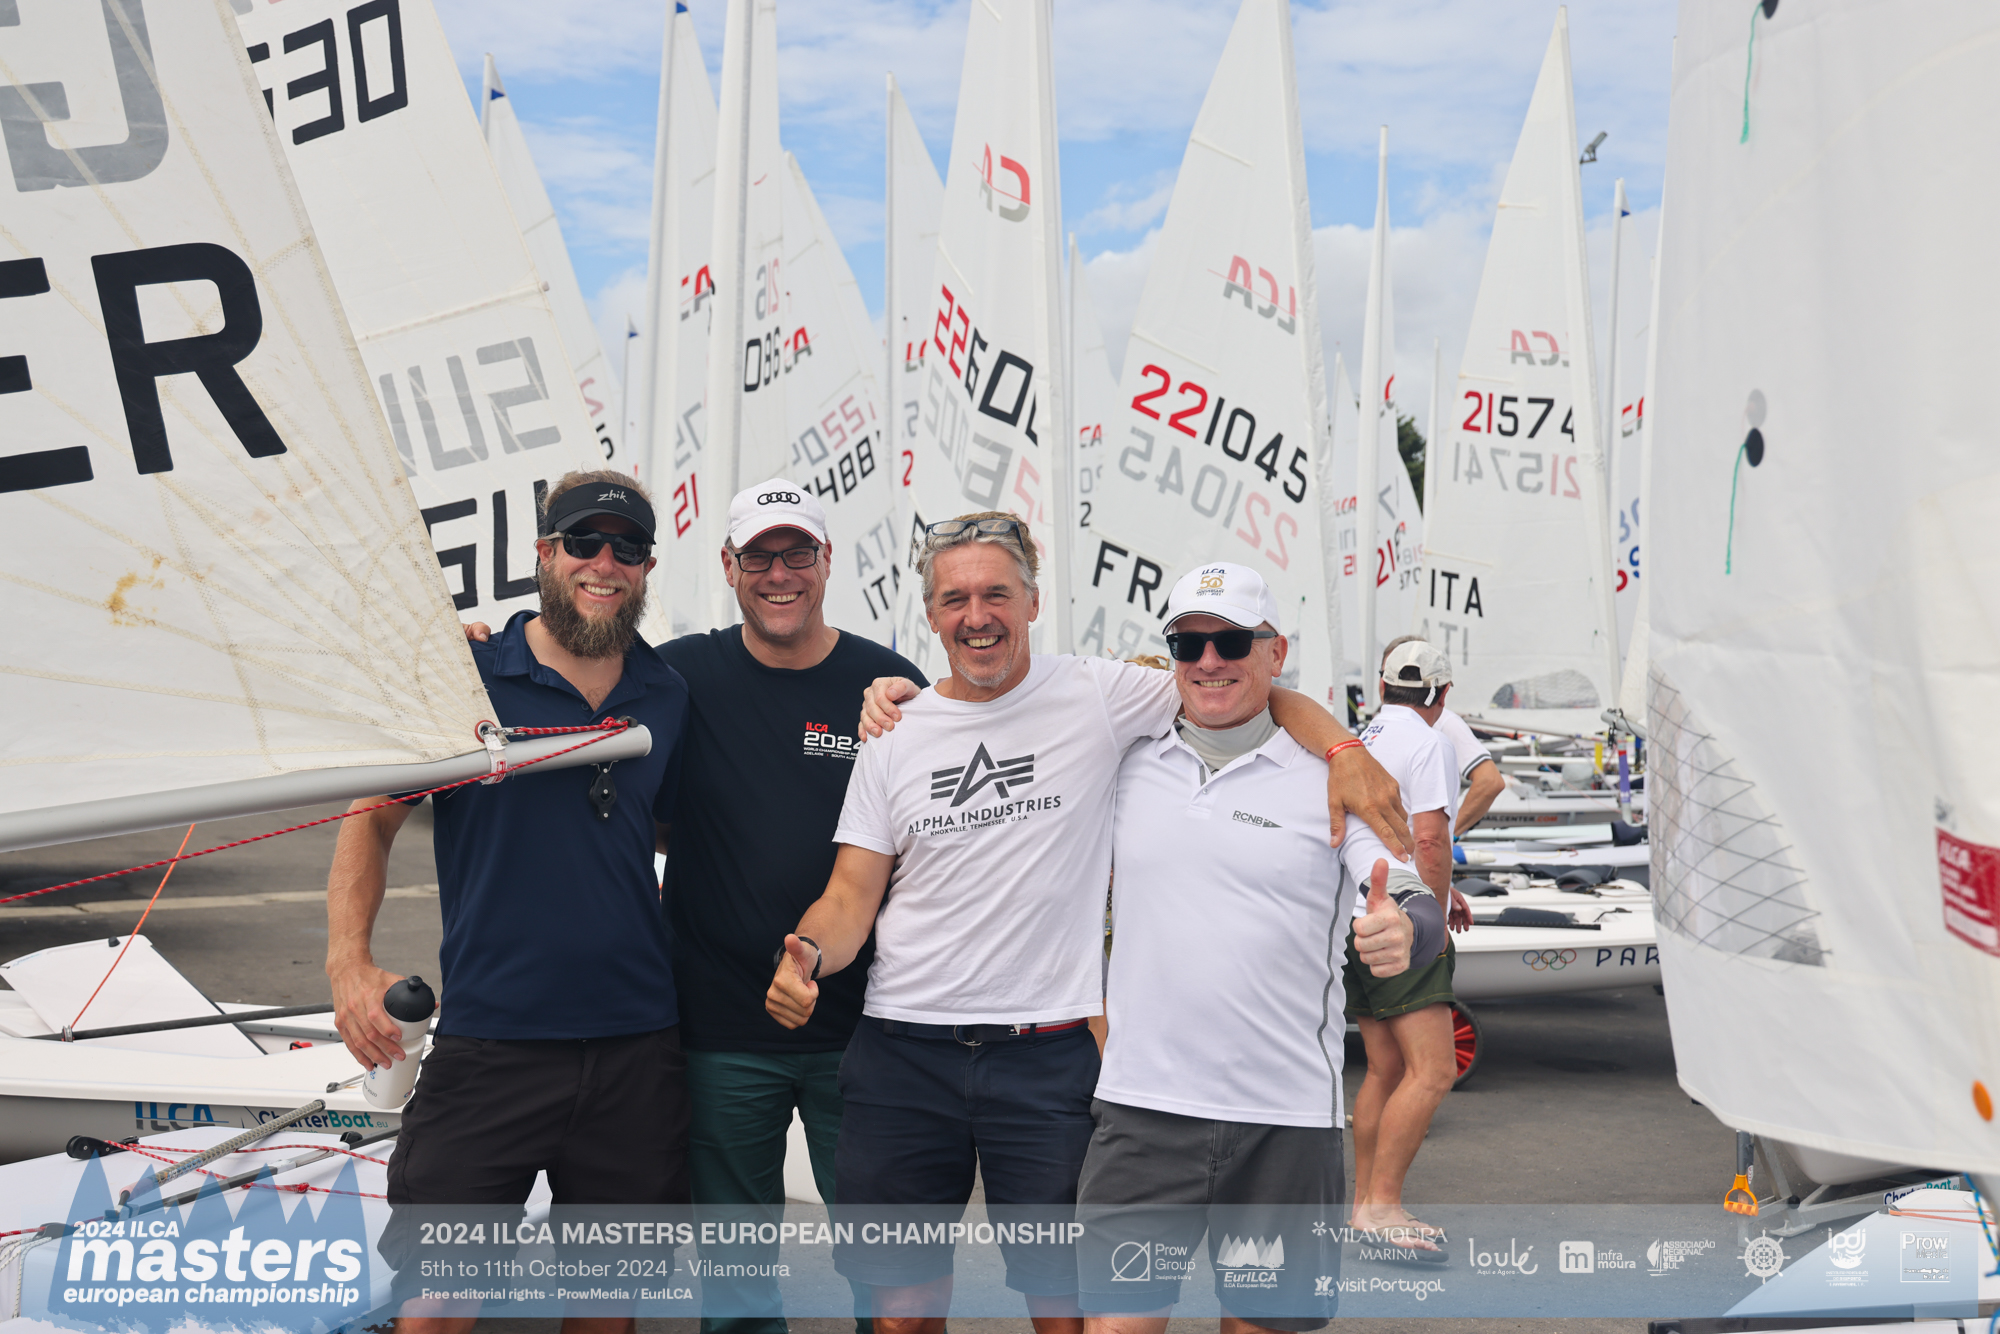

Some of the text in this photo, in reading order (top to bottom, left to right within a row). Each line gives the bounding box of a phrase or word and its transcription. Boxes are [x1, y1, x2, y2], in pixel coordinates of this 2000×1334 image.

[1131, 363, 1308, 503] 221045
[597, 489, 629, 504] zhik
[1093, 540, 1170, 620] FR
[1430, 568, 1483, 618] ITA
[806, 721, 828, 733] ILCA
[1365, 725, 1385, 735] FRA
[907, 795, 1062, 836] ALPHA INDUSTRIES
[1233, 810, 1263, 825] RCNB
